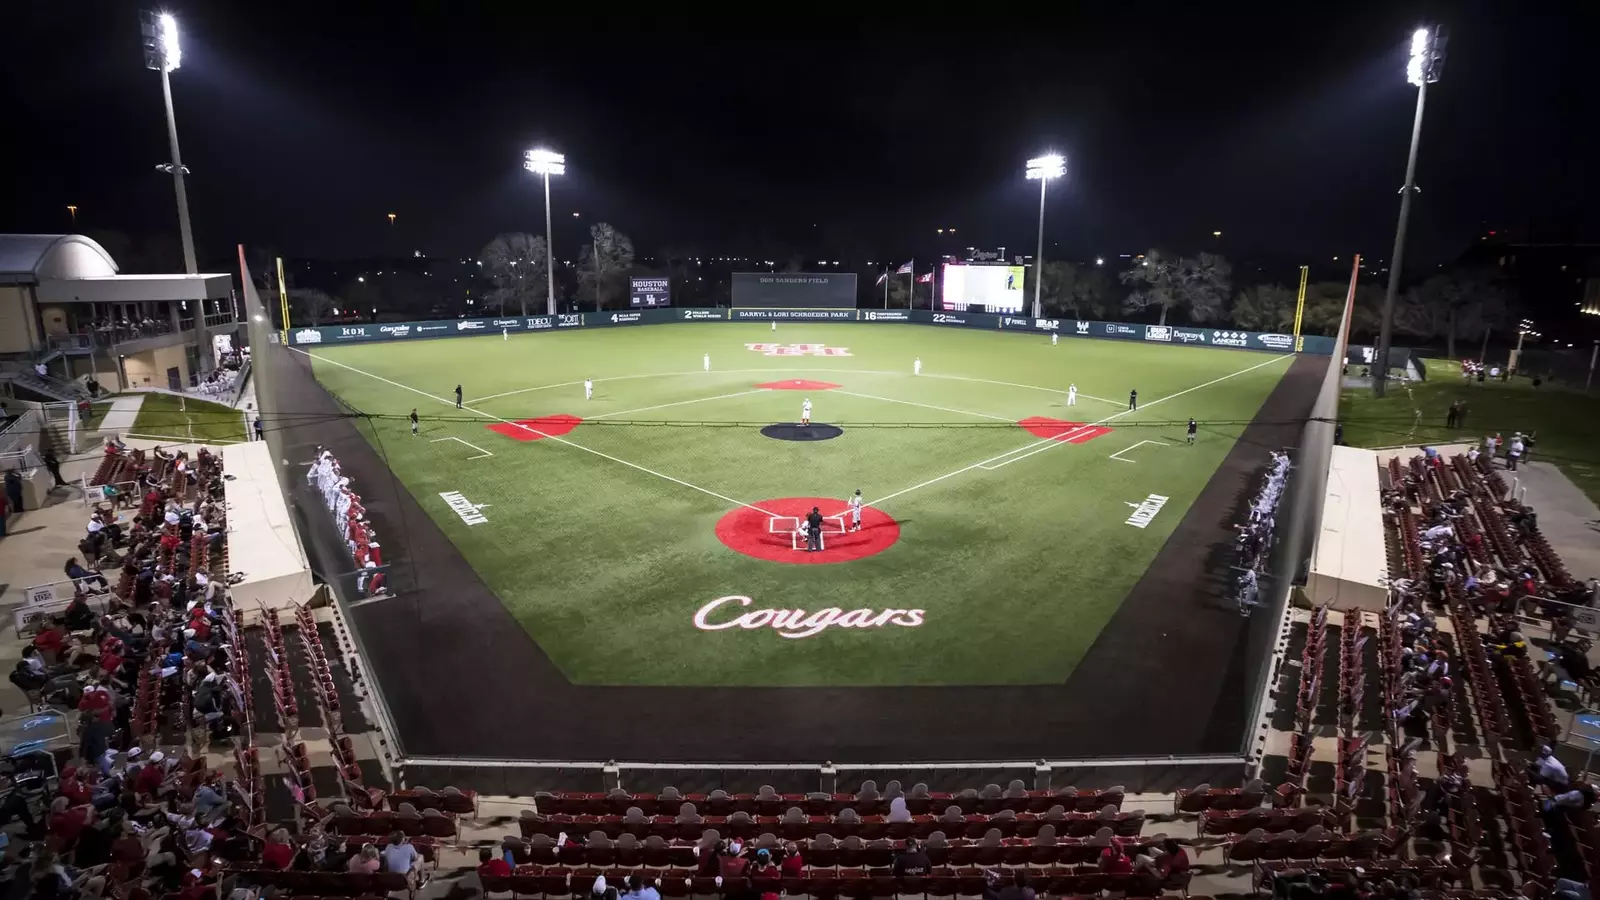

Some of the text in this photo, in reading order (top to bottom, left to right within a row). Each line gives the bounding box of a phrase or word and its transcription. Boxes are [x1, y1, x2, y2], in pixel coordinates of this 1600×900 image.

[632, 280, 668, 288] HOUSTON
[610, 313, 618, 323] 4
[684, 310, 692, 319] 2
[864, 311, 877, 320] 16
[932, 313, 946, 323] 22
[526, 317, 553, 326] TDECU
[1147, 331, 1170, 340] LIGHT
[693, 595, 927, 639] Cougars
